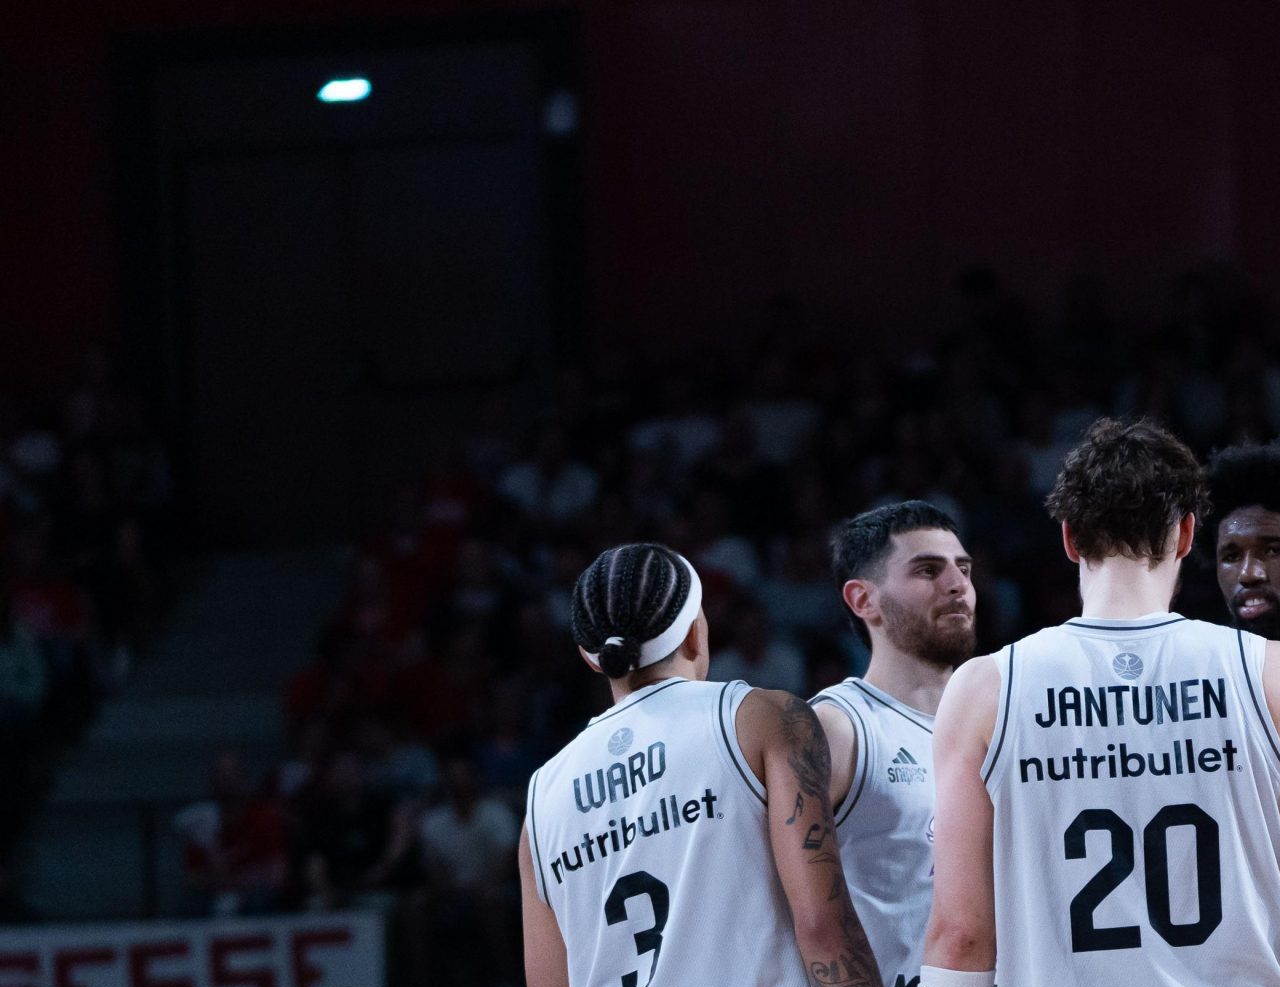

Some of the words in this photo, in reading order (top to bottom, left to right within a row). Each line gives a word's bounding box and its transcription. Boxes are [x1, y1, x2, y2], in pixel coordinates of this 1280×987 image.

[1035, 678, 1228, 728] JANTUNEN
[573, 741, 666, 814] WARD
[1063, 803, 1222, 952] 20
